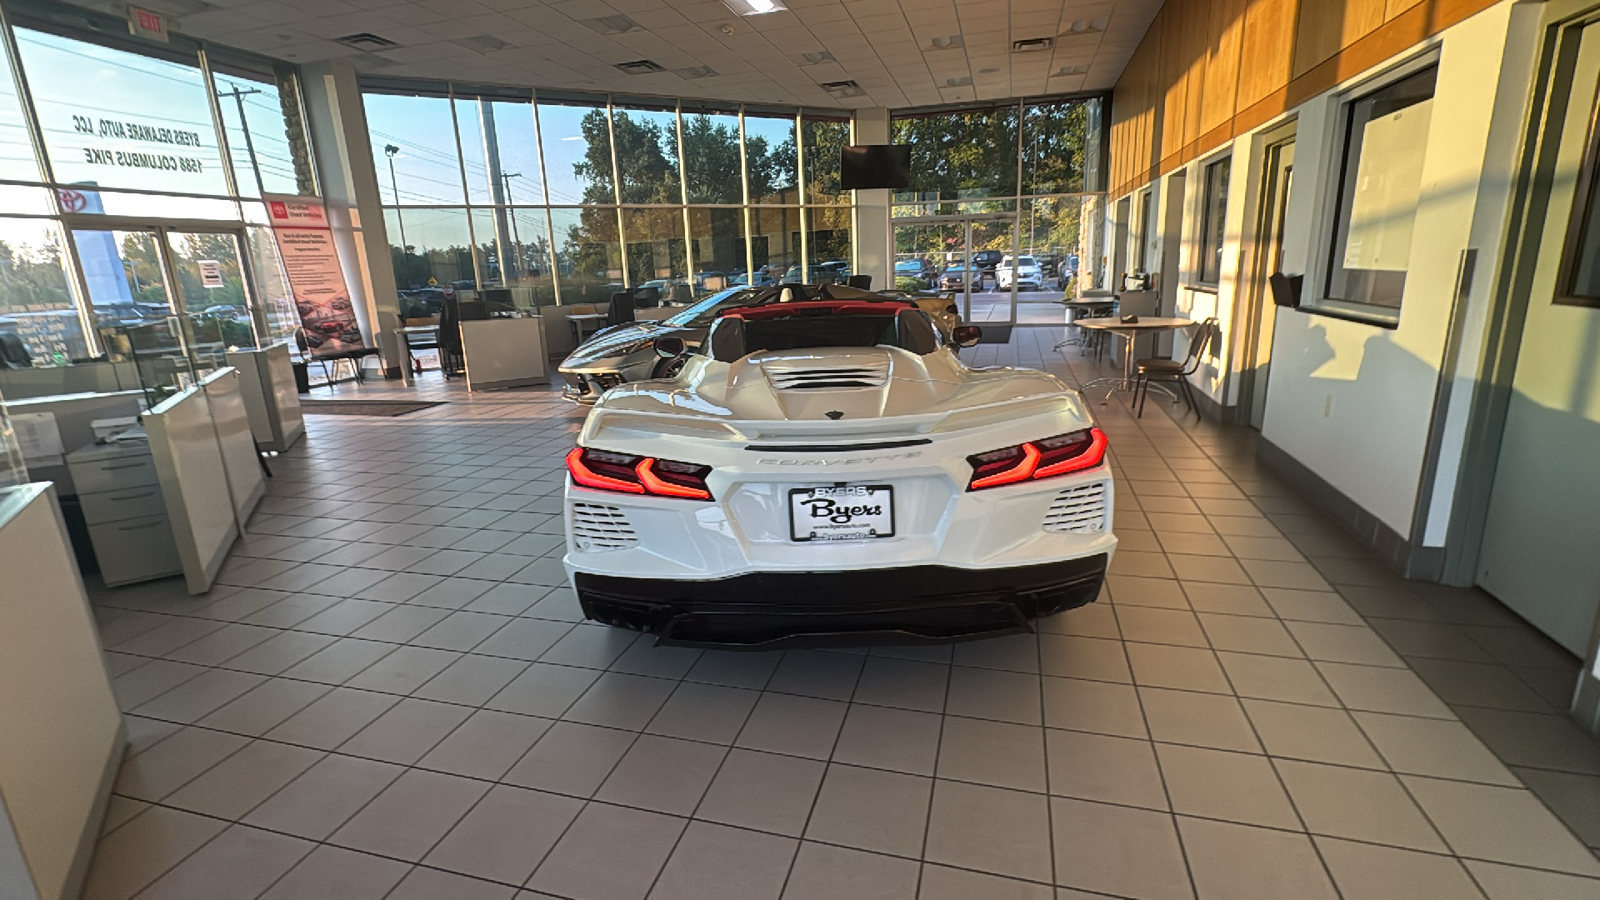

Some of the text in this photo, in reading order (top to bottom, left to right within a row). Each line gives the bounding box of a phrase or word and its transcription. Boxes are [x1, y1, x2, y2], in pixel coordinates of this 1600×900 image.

[137, 11, 160, 32] EXIT
[756, 452, 921, 466] CORVETTE
[814, 486, 868, 497] BYERS
[800, 498, 882, 524] Byers
